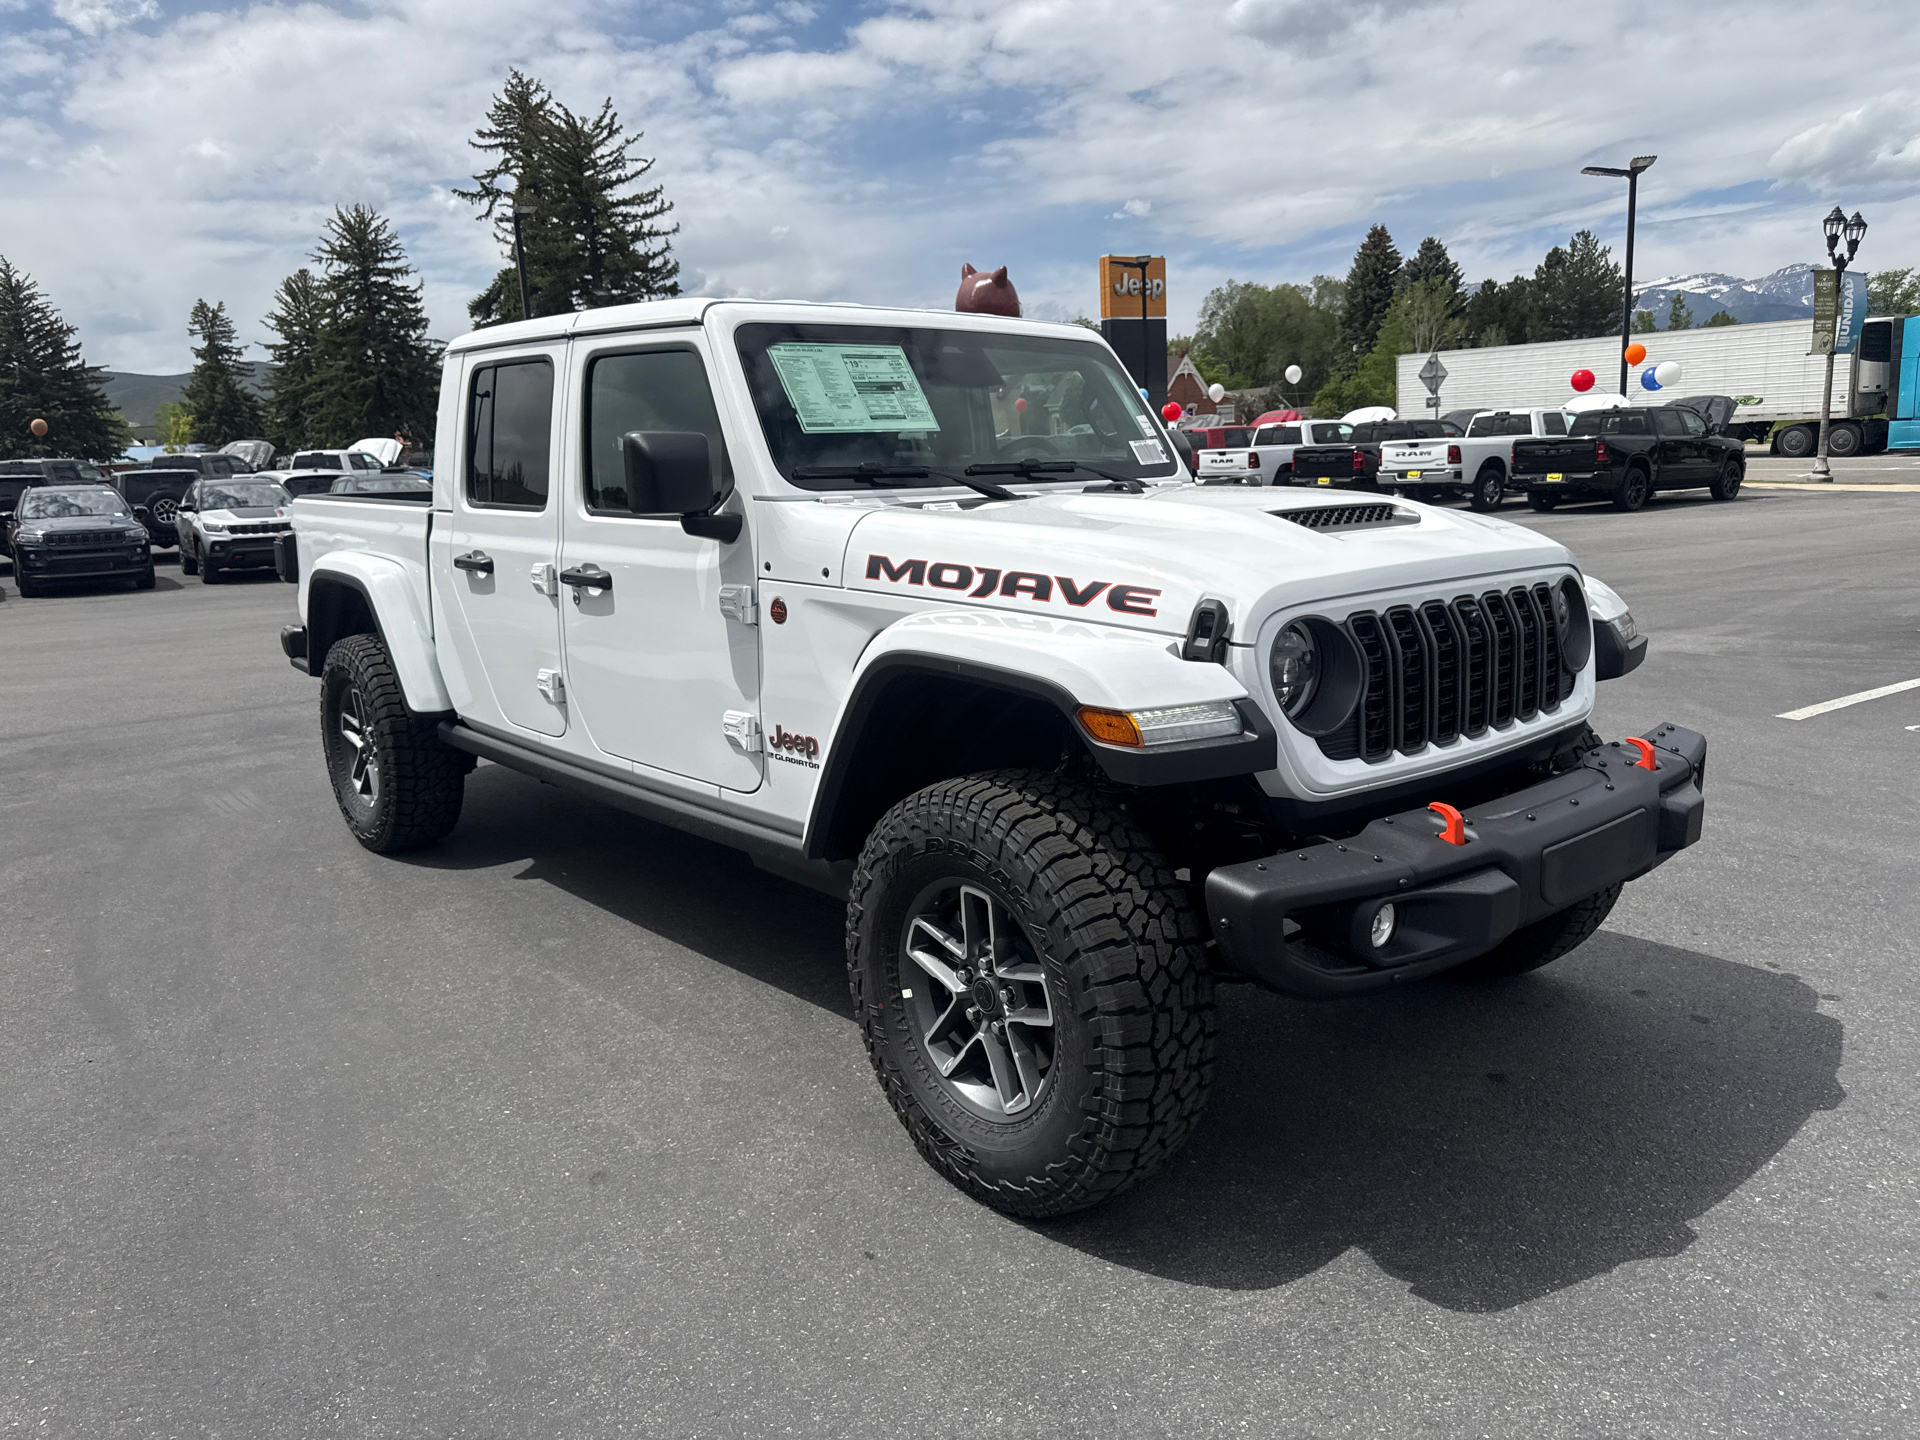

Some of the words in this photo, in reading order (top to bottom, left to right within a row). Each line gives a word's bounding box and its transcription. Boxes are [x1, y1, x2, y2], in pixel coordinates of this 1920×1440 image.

[1114, 272, 1164, 300] Jeep
[1840, 278, 1854, 335] UNIDAD
[849, 360, 859, 368] 19
[865, 554, 1162, 617] MOJAVE
[769, 724, 819, 760] Jeep
[774, 753, 820, 770] GLADIATOR
